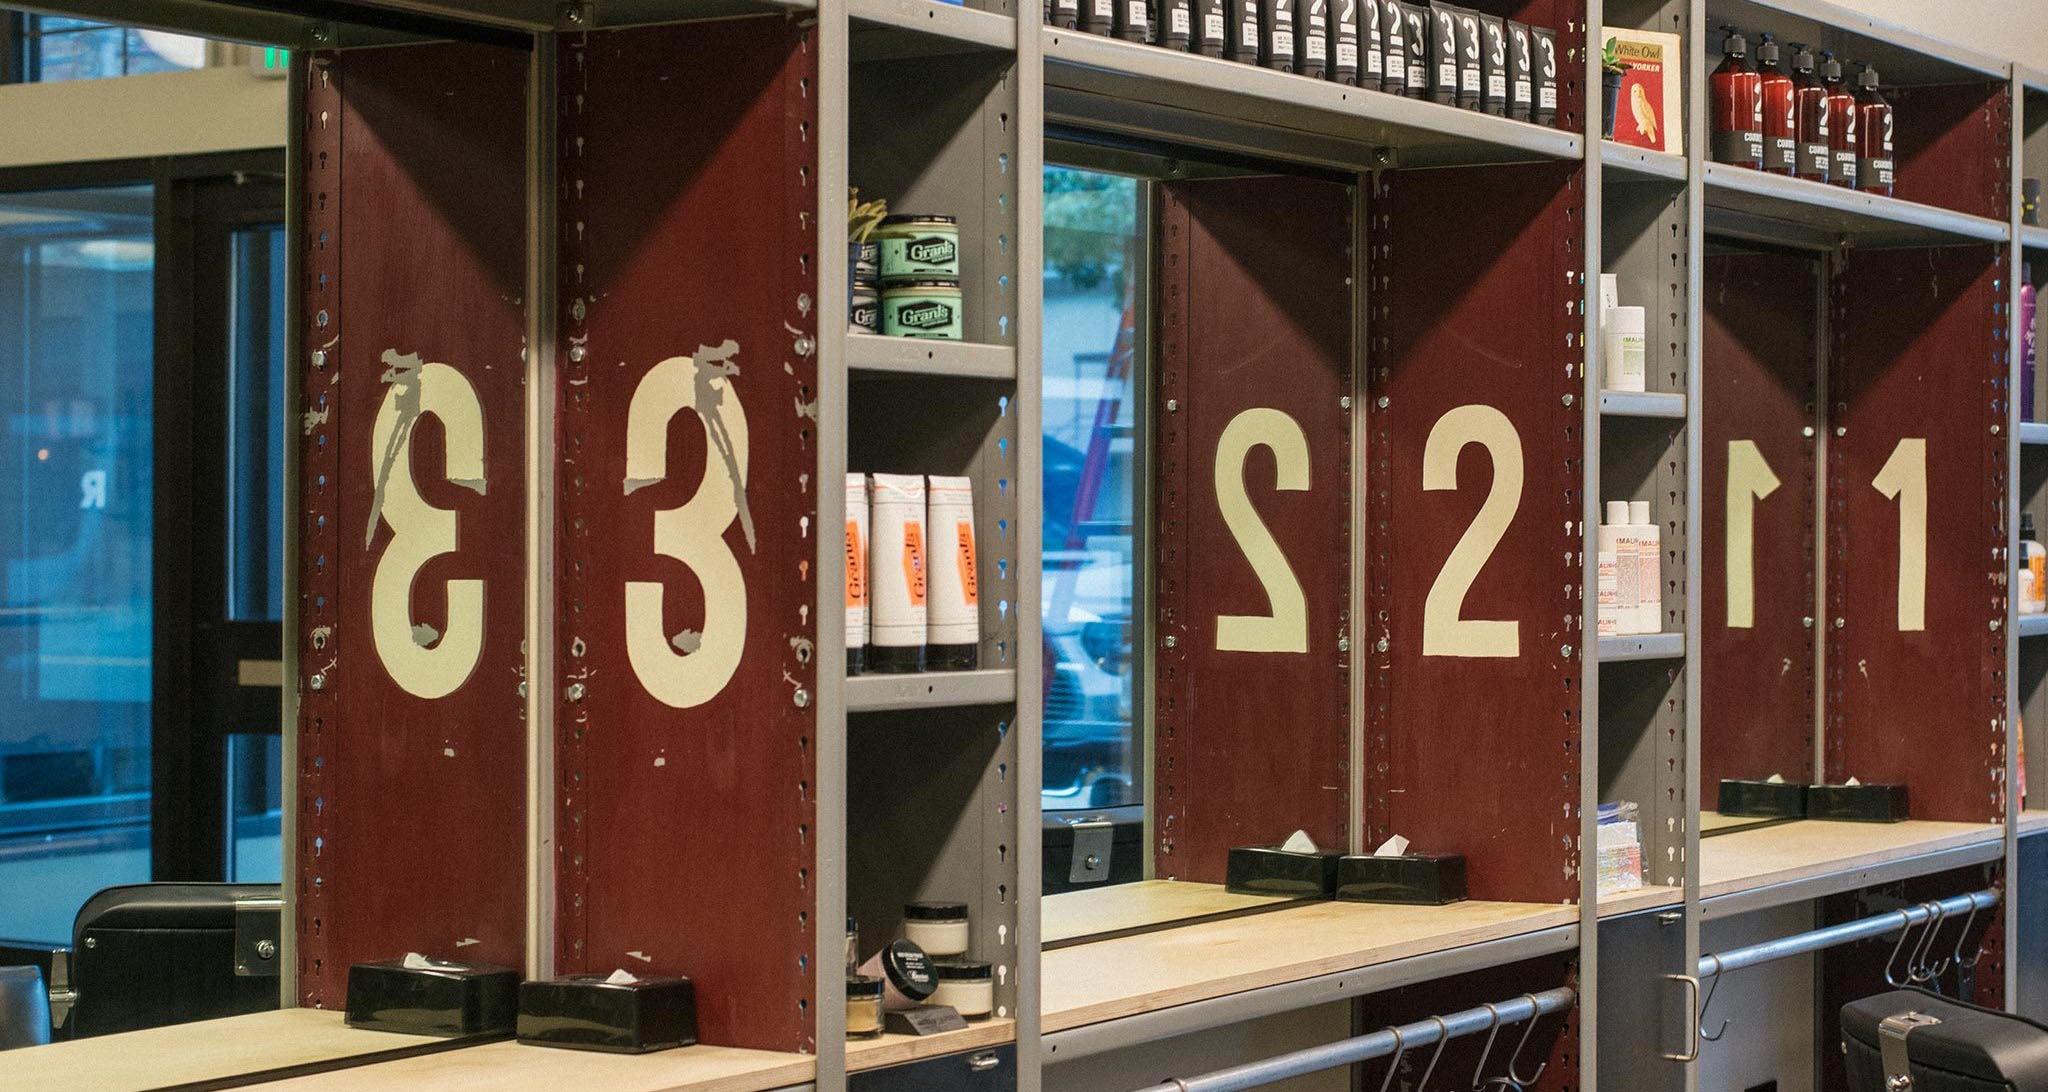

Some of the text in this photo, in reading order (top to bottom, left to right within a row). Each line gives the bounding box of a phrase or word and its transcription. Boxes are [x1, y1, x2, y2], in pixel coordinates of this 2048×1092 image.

[1408, 13, 1424, 56] 3
[1439, 11, 1456, 55] 3
[1463, 17, 1480, 60] 3
[1489, 24, 1505, 66] 3
[1516, 30, 1530, 72] 3
[1615, 44, 1660, 58] White Owl
[1541, 36, 1556, 78] 3
[1632, 62, 1660, 72] YORKER
[626, 356, 748, 709] 3
[1423, 404, 1524, 658] 2
[1871, 438, 1927, 632] 1
